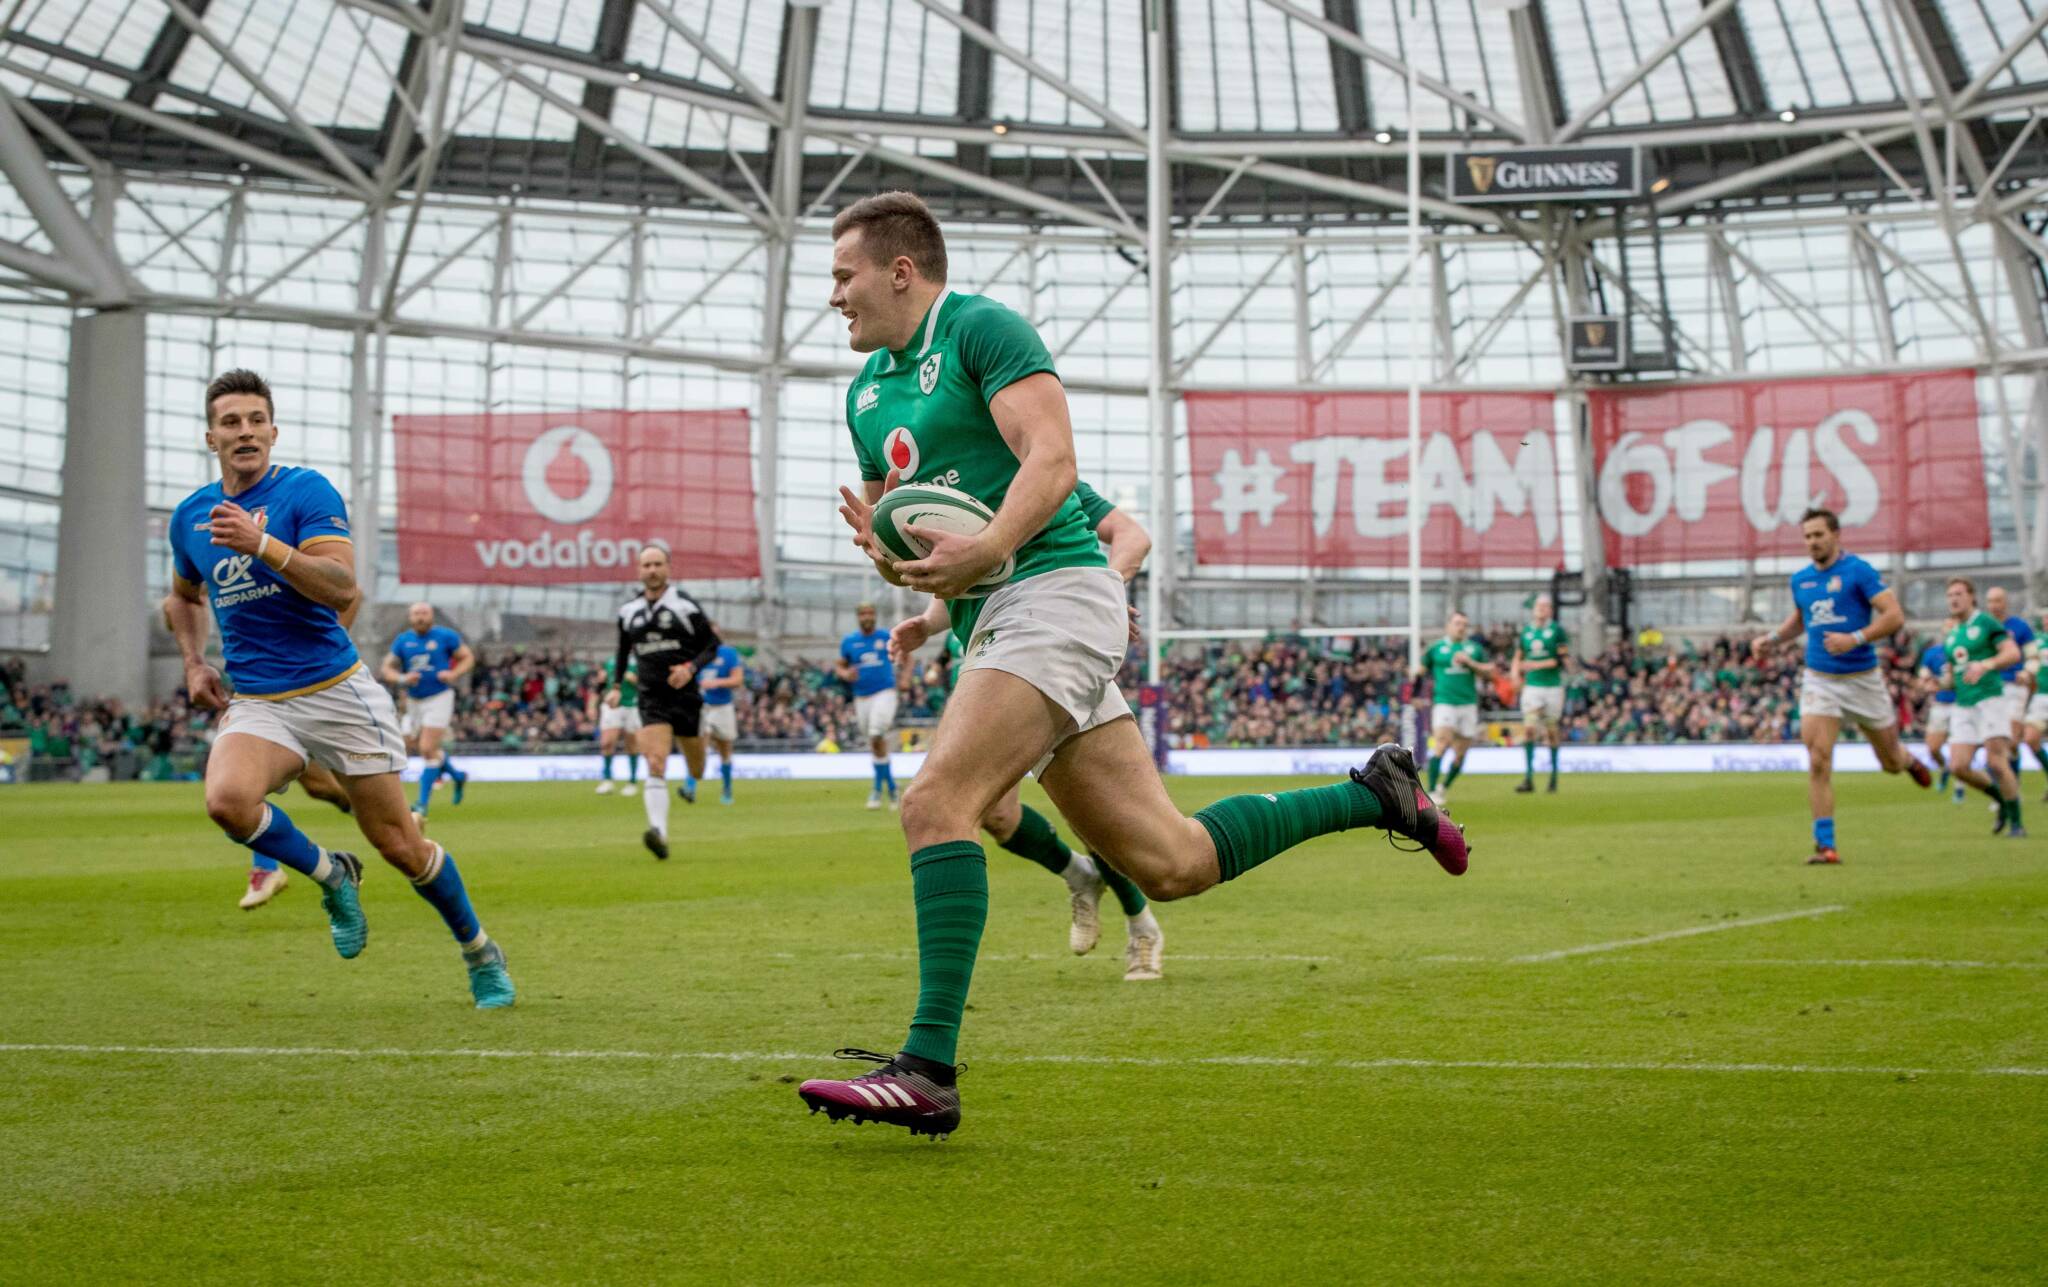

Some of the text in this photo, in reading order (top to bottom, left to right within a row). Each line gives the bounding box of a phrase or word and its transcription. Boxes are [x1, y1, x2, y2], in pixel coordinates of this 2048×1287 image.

[1496, 161, 1619, 188] GUINNESS
[1211, 428, 1558, 548] #TEAM
[475, 530, 671, 568] vodafon
[215, 583, 282, 609] CARIPARMA
